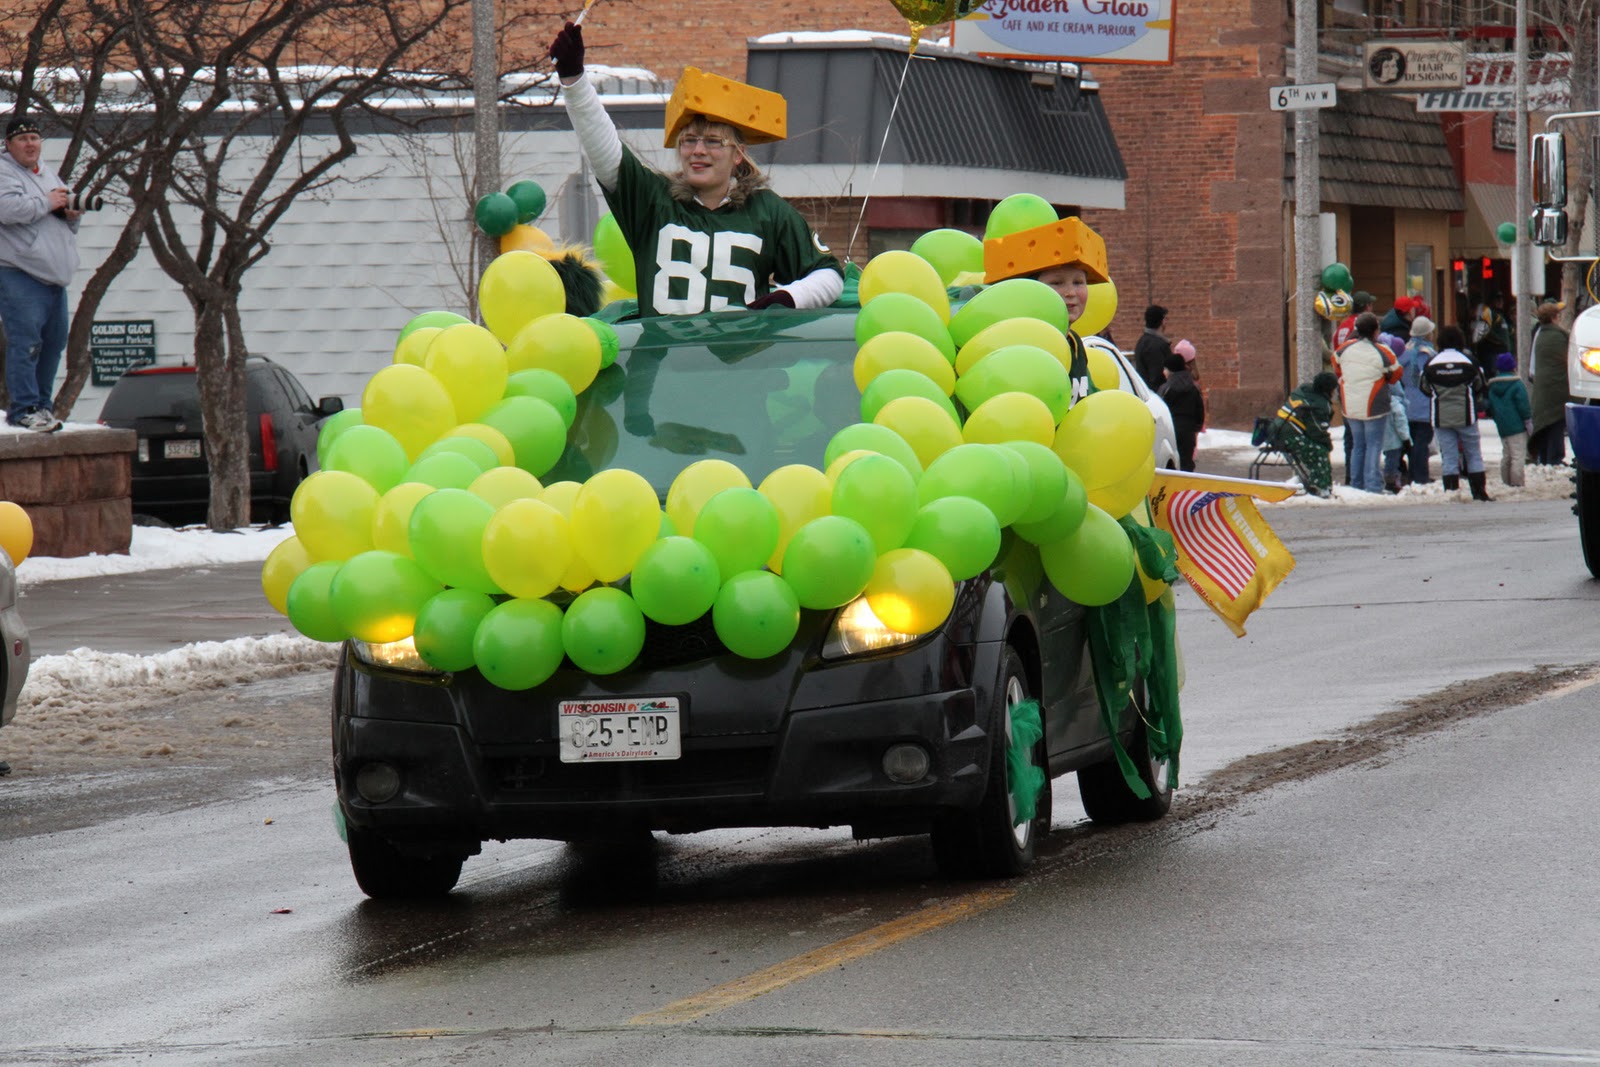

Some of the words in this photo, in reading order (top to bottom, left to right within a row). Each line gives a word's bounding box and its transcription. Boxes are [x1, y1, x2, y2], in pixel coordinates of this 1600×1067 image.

[1002, 20, 1022, 31] CAFE
[1027, 21, 1045, 32] AND
[1047, 22, 1060, 33] ICE
[1063, 22, 1095, 34] CREAM
[1098, 24, 1136, 37] PARLOUR
[1417, 62, 1444, 71] HAIR
[1404, 71, 1458, 81] DESIGNING
[1305, 91, 1316, 101] AV
[1321, 91, 1329, 100] W
[653, 223, 763, 315] 85
[92, 324, 126, 335] GOLDEN
[127, 324, 153, 335] GLOW
[126, 335, 153, 345] Parking
[1231, 511, 1269, 559] VETERANS
[563, 702, 627, 714] WISCONSIN
[571, 715, 669, 748] 825-EMB
[621, 750, 653, 758] Dairyland
